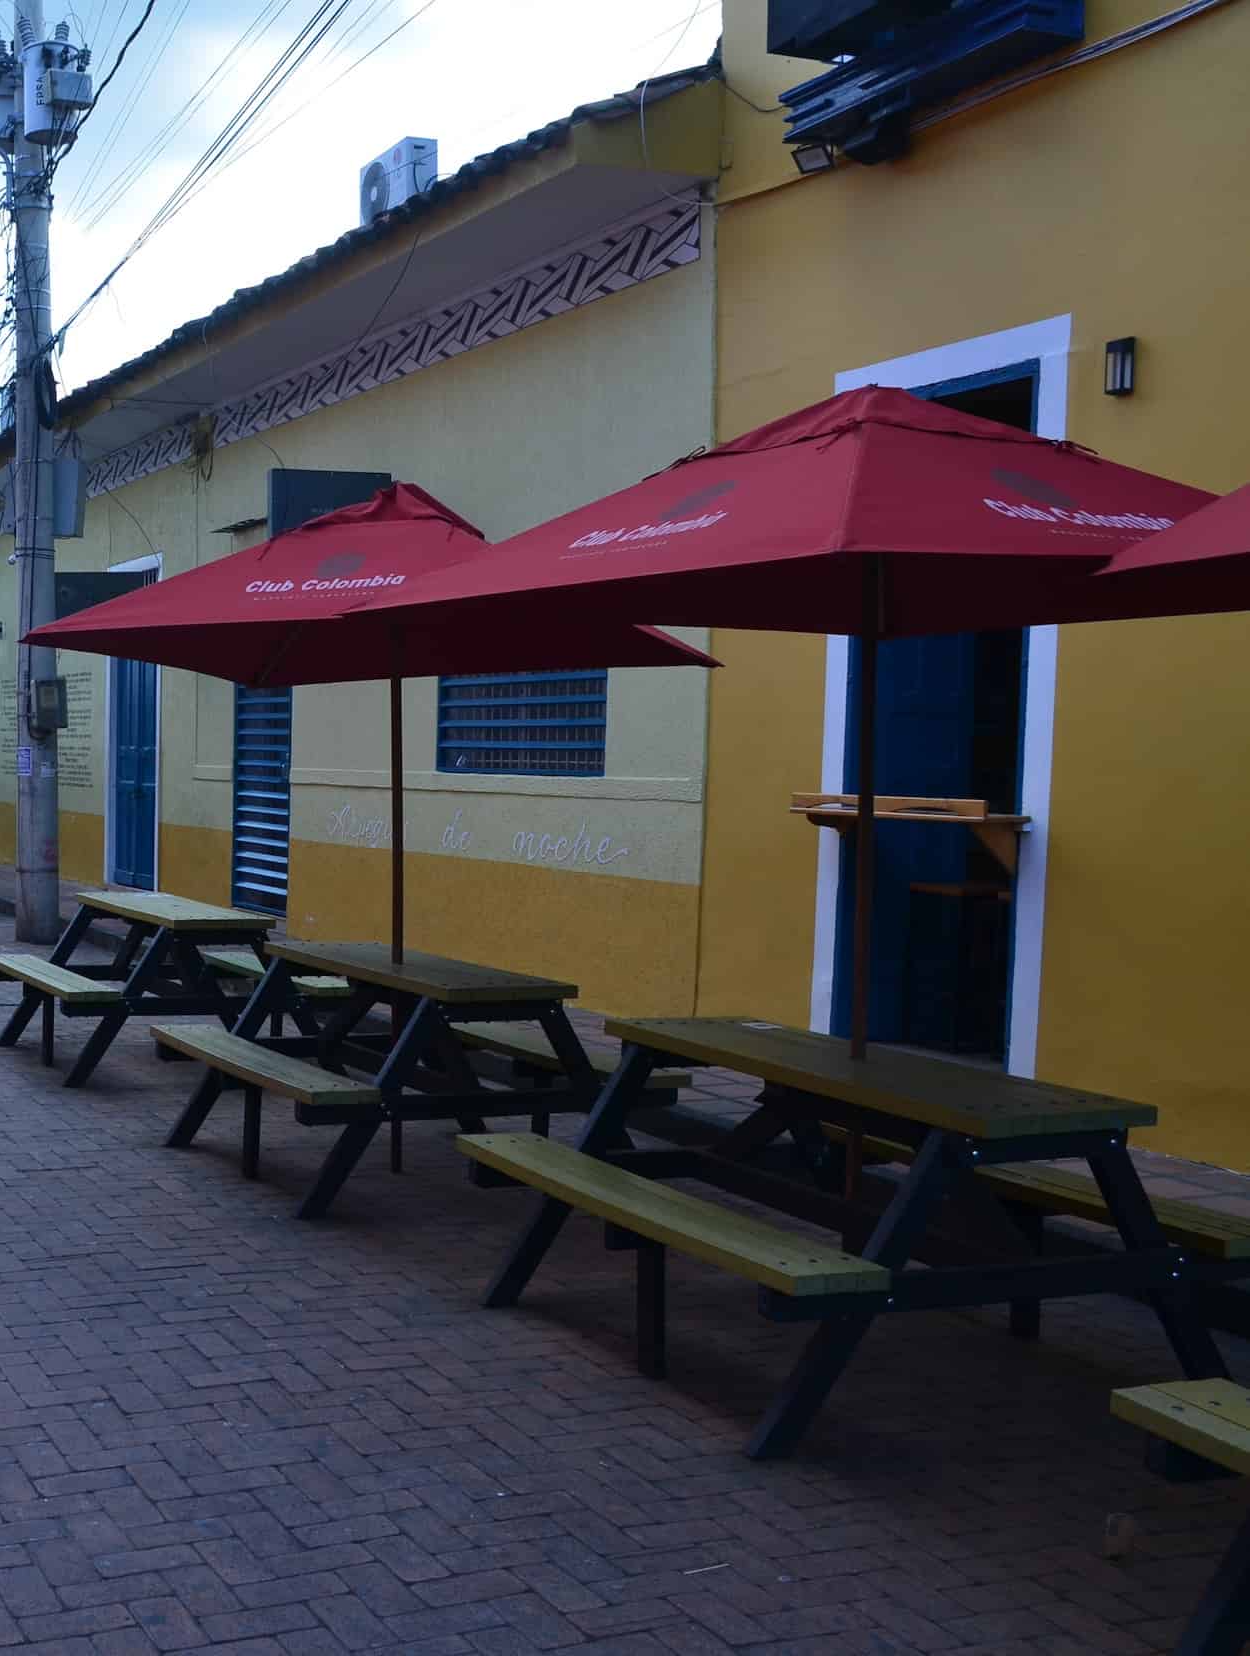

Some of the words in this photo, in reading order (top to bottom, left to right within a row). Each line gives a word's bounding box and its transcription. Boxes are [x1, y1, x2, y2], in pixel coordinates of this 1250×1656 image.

[982, 497, 1057, 522] Club
[568, 527, 627, 549] Club
[617, 509, 730, 542] Colombia
[244, 579, 295, 593] Club
[301, 572, 406, 591] Colombia
[512, 818, 630, 865] noche
